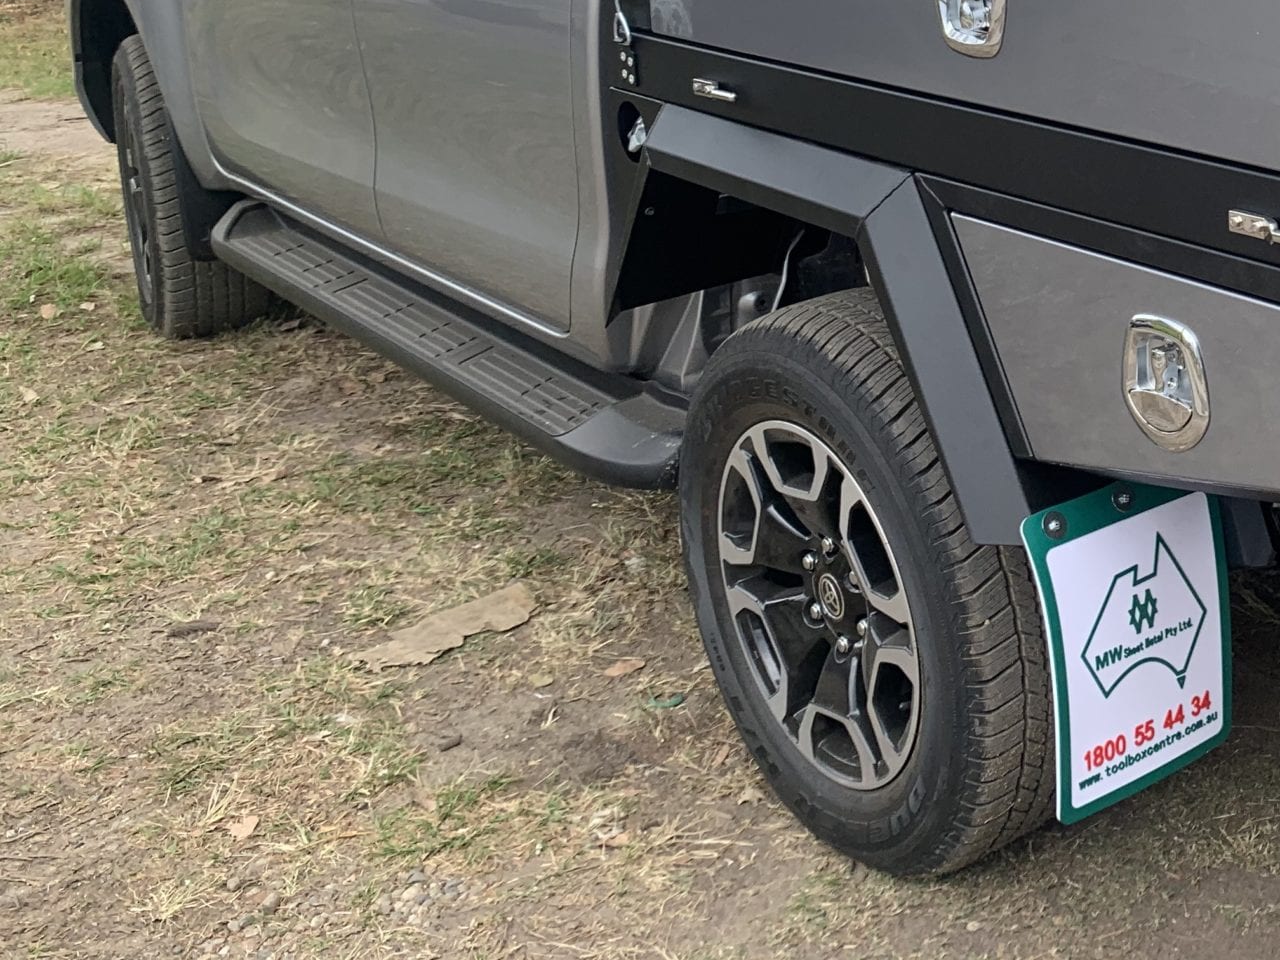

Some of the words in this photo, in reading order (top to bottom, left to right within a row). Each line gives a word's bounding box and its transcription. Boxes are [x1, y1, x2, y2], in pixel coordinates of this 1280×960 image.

[1095, 644, 1122, 671] MW
[1165, 627, 1177, 639] Pty
[1084, 734, 1126, 771] 1800
[1134, 719, 1155, 746] 55
[1163, 704, 1185, 730] 44
[1191, 690, 1211, 716] 34
